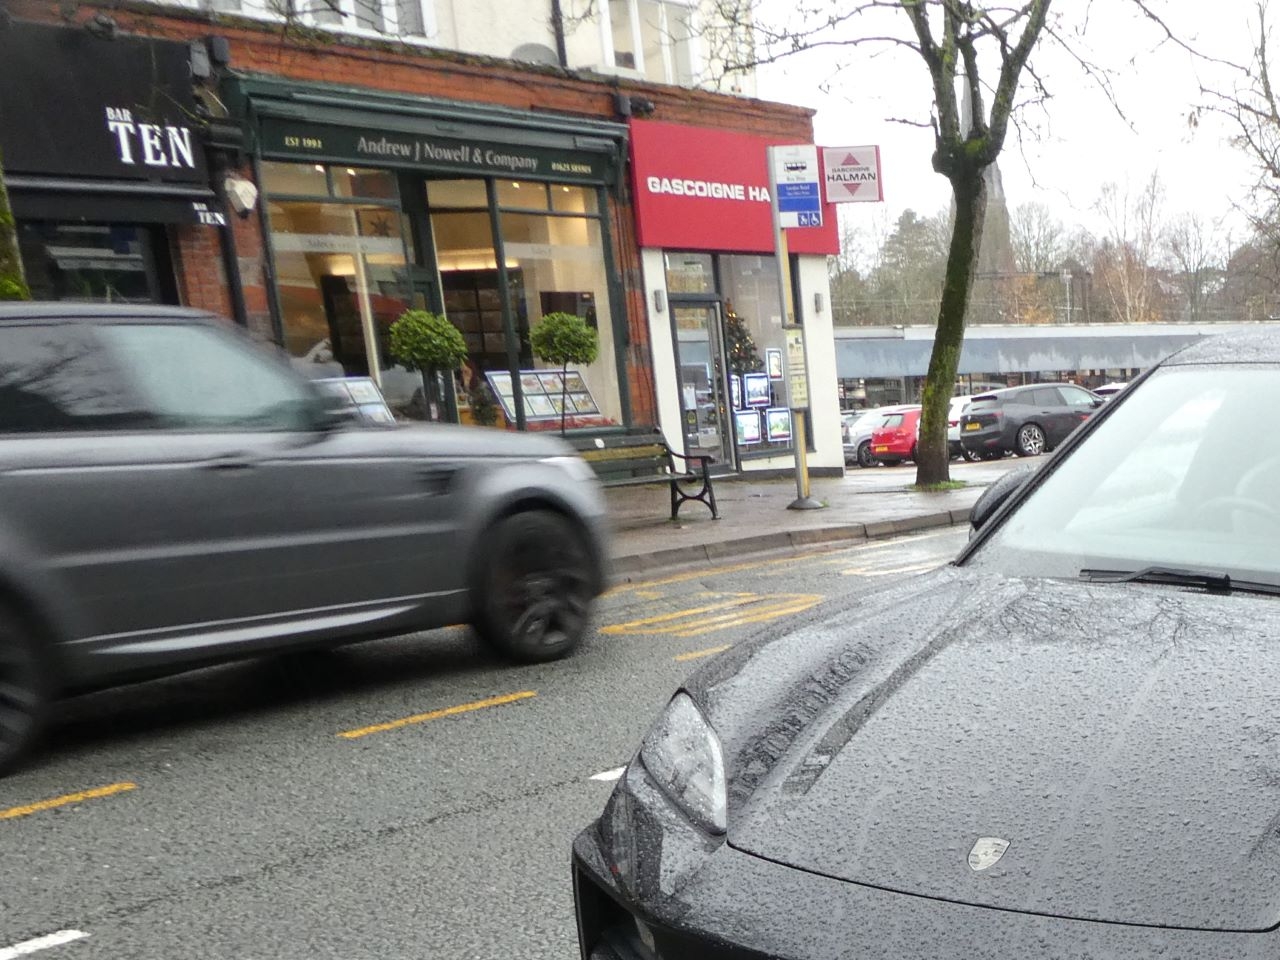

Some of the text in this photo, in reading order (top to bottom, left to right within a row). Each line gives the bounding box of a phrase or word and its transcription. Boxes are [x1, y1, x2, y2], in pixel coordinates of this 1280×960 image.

[105, 106, 132, 121] BAR
[107, 121, 195, 168] TEN
[285, 136, 299, 147] EST
[357, 136, 539, 171] Andrew J Nowell & Company
[827, 173, 876, 181] HALMAN
[647, 176, 745, 200] GASCOIGNE
[198, 212, 226, 225] TEN
